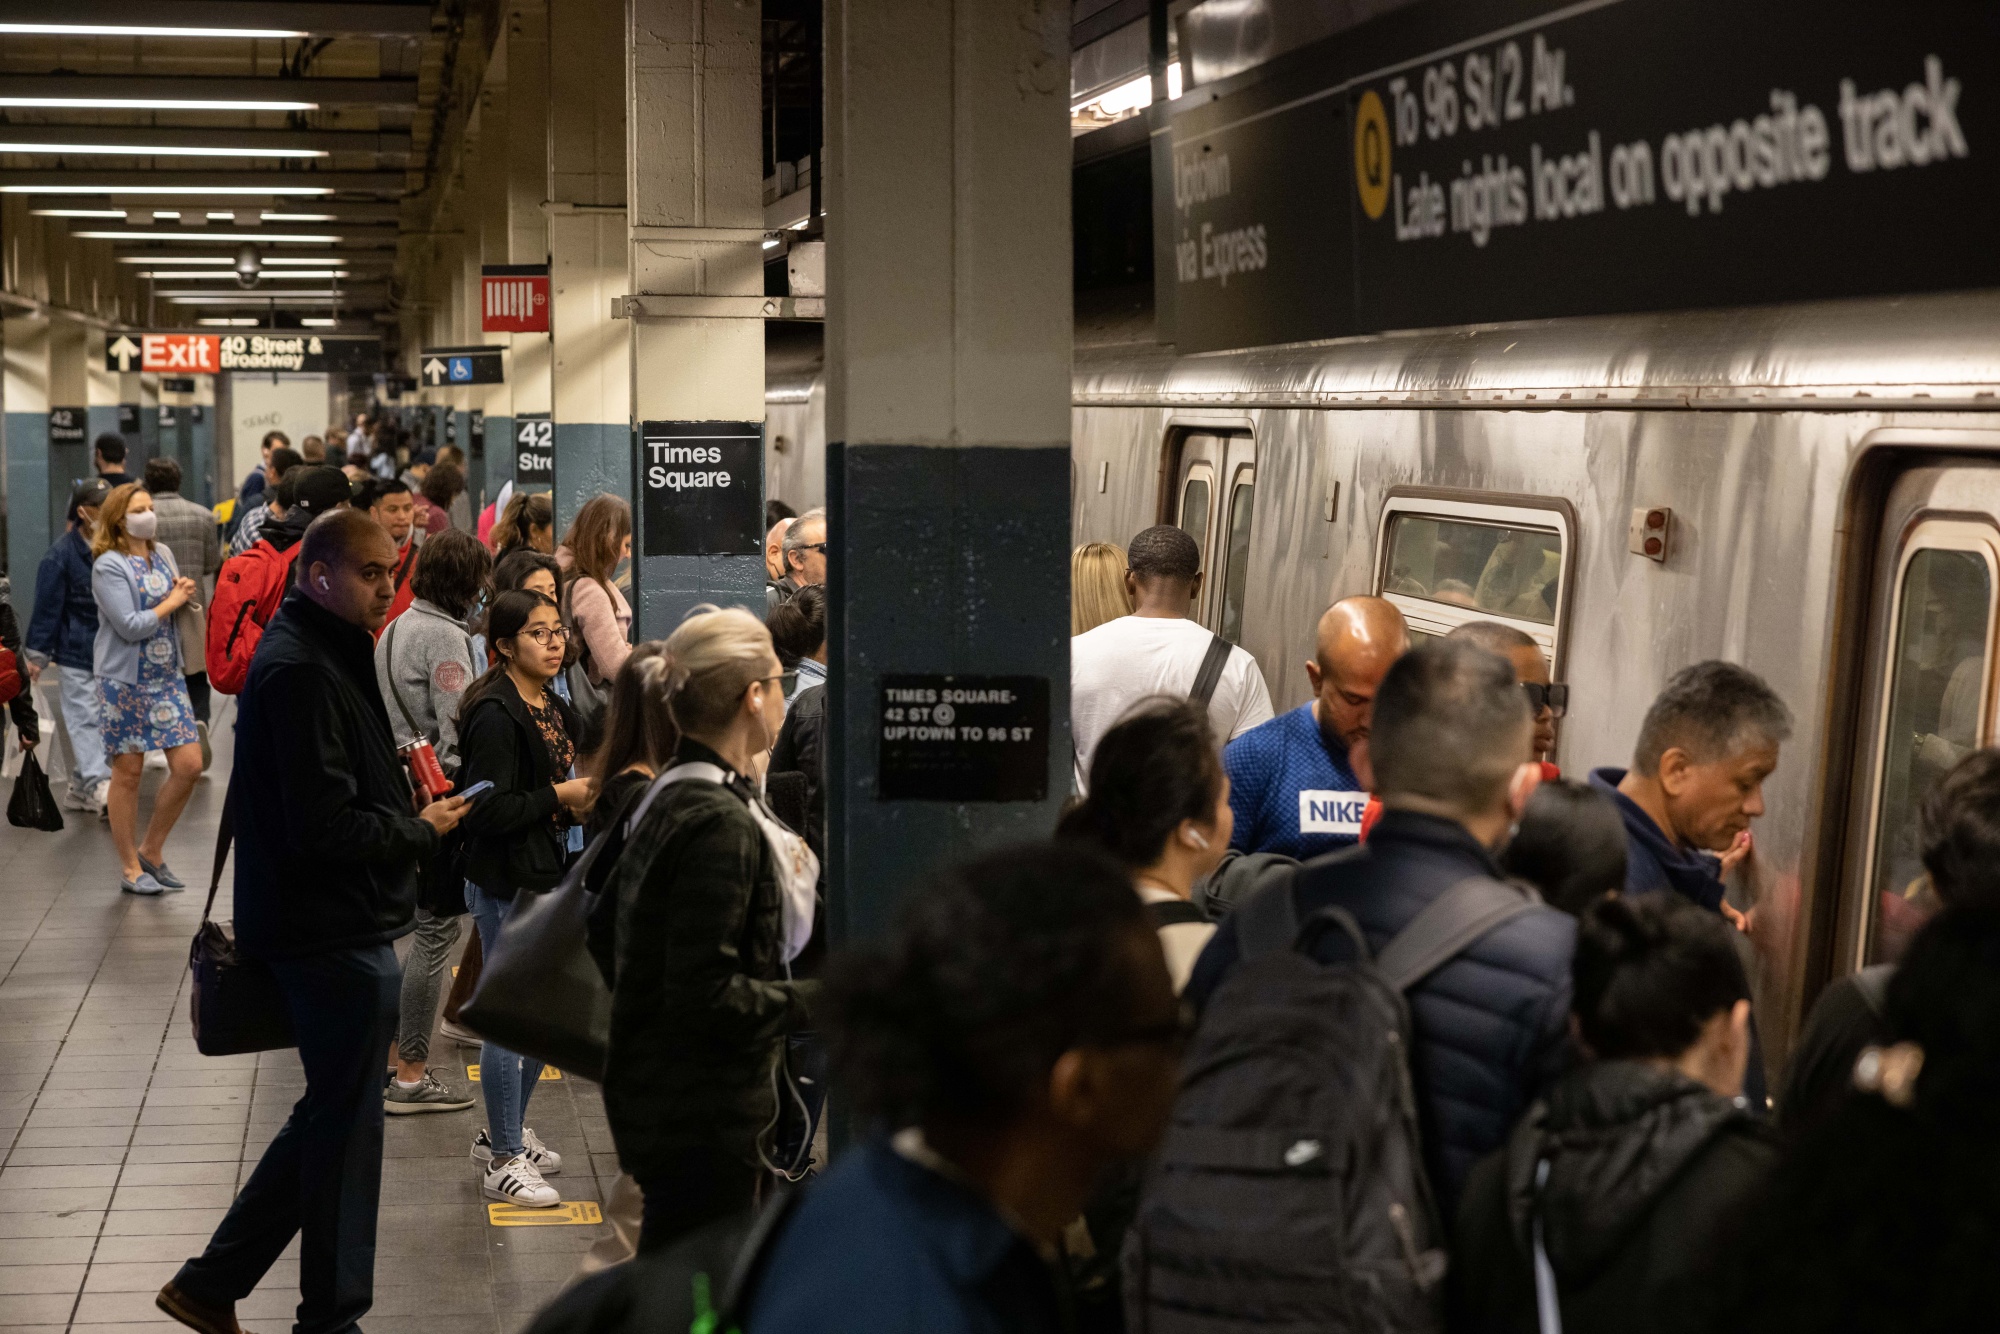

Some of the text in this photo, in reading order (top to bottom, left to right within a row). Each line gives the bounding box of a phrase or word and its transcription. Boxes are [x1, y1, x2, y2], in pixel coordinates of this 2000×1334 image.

[1389, 76, 1419, 146] To
[1423, 61, 1459, 139] 96
[1394, 53, 1970, 248] Late nights local on opposite track
[1173, 152, 1231, 217] Uptown
[1177, 222, 1267, 288] via Express
[143, 336, 211, 368] Exit
[220, 336, 323, 354] 40 Street &
[220, 352, 304, 370] Broadway
[51, 410, 73, 427] 42
[52, 427, 84, 439] Street
[518, 422, 552, 447] 42
[648, 442, 722, 464] Times
[648, 466, 731, 492] Square
[885, 688, 938, 704] TIMES
[884, 707, 905, 722] 42
[908, 707, 931, 723] ST
[883, 726, 1033, 742] UPTOWN TO 96 ST
[1309, 800, 1365, 823] NIKE
